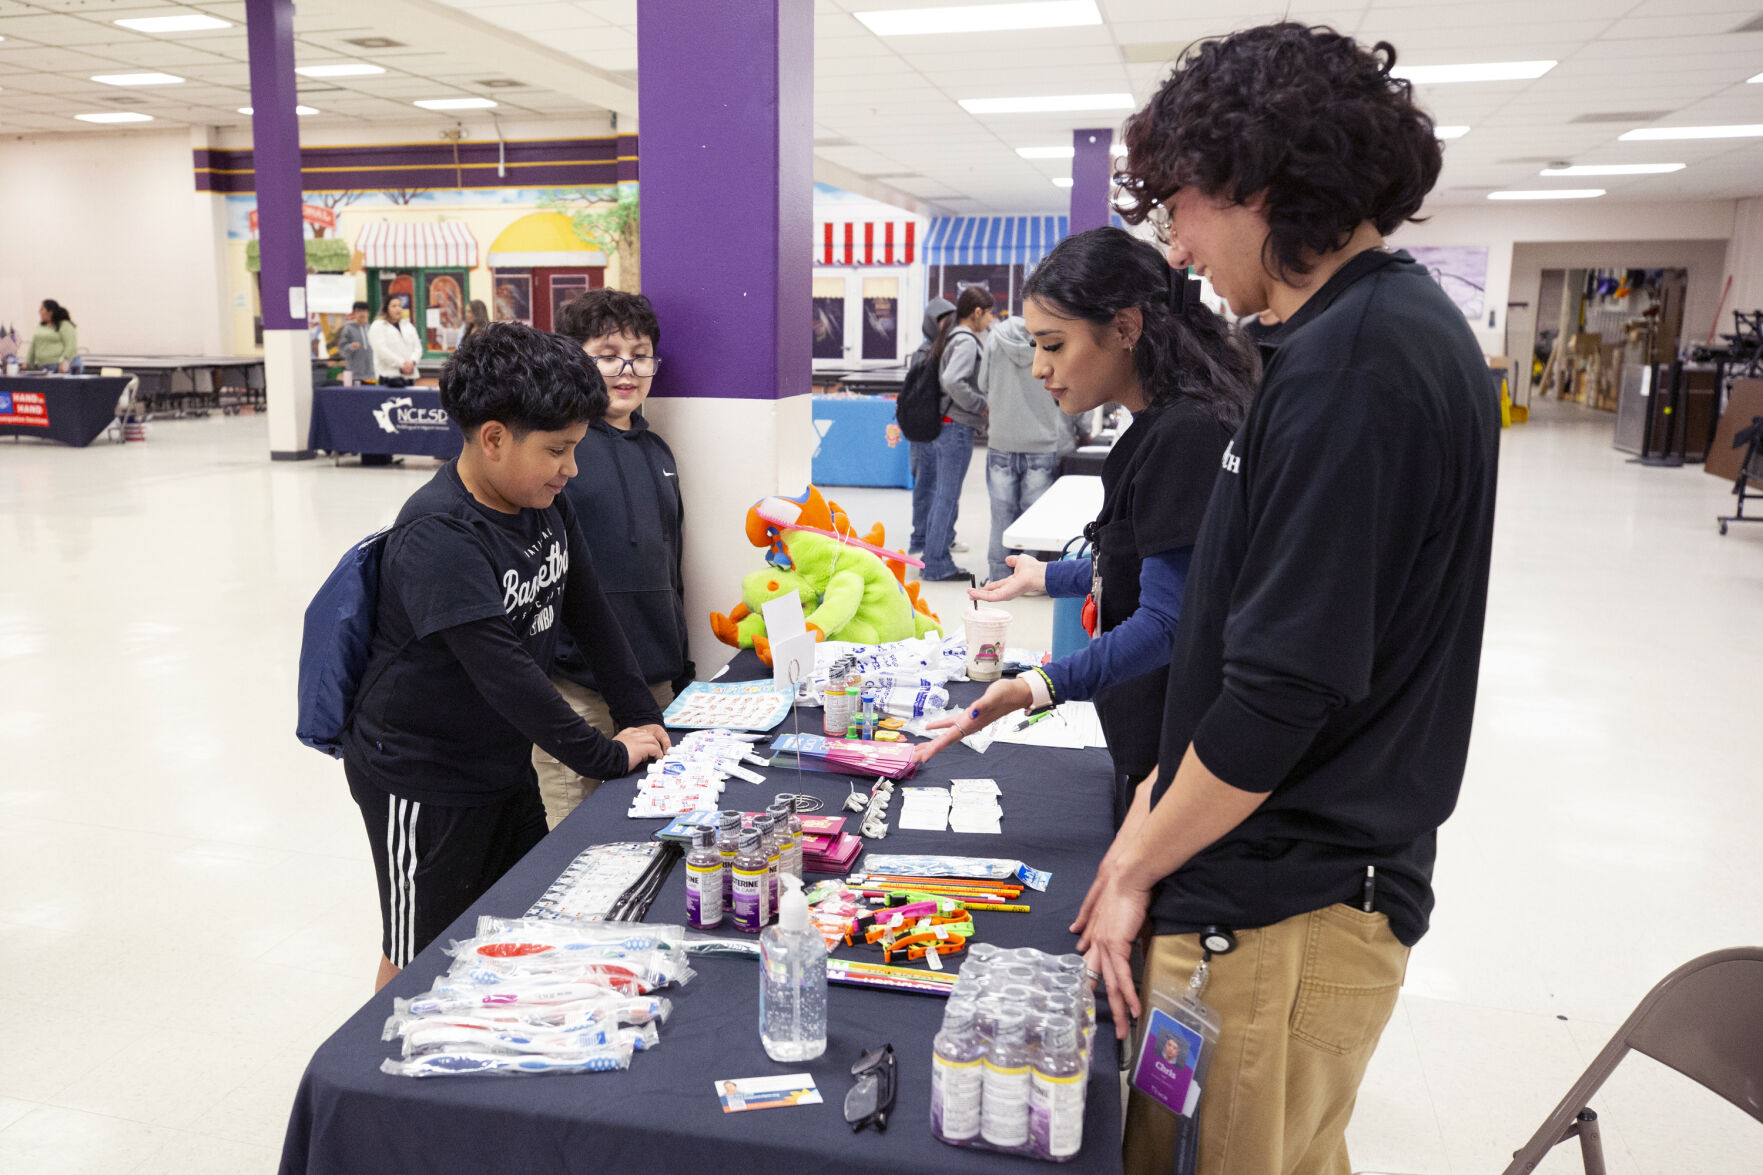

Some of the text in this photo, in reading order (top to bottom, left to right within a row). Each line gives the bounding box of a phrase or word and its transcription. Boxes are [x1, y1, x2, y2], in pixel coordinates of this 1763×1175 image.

[13, 393, 38, 403] HAND
[18, 404, 43, 414] HAND
[397, 408, 448, 422] NCESD
[1155, 1061, 1177, 1079] Chris
